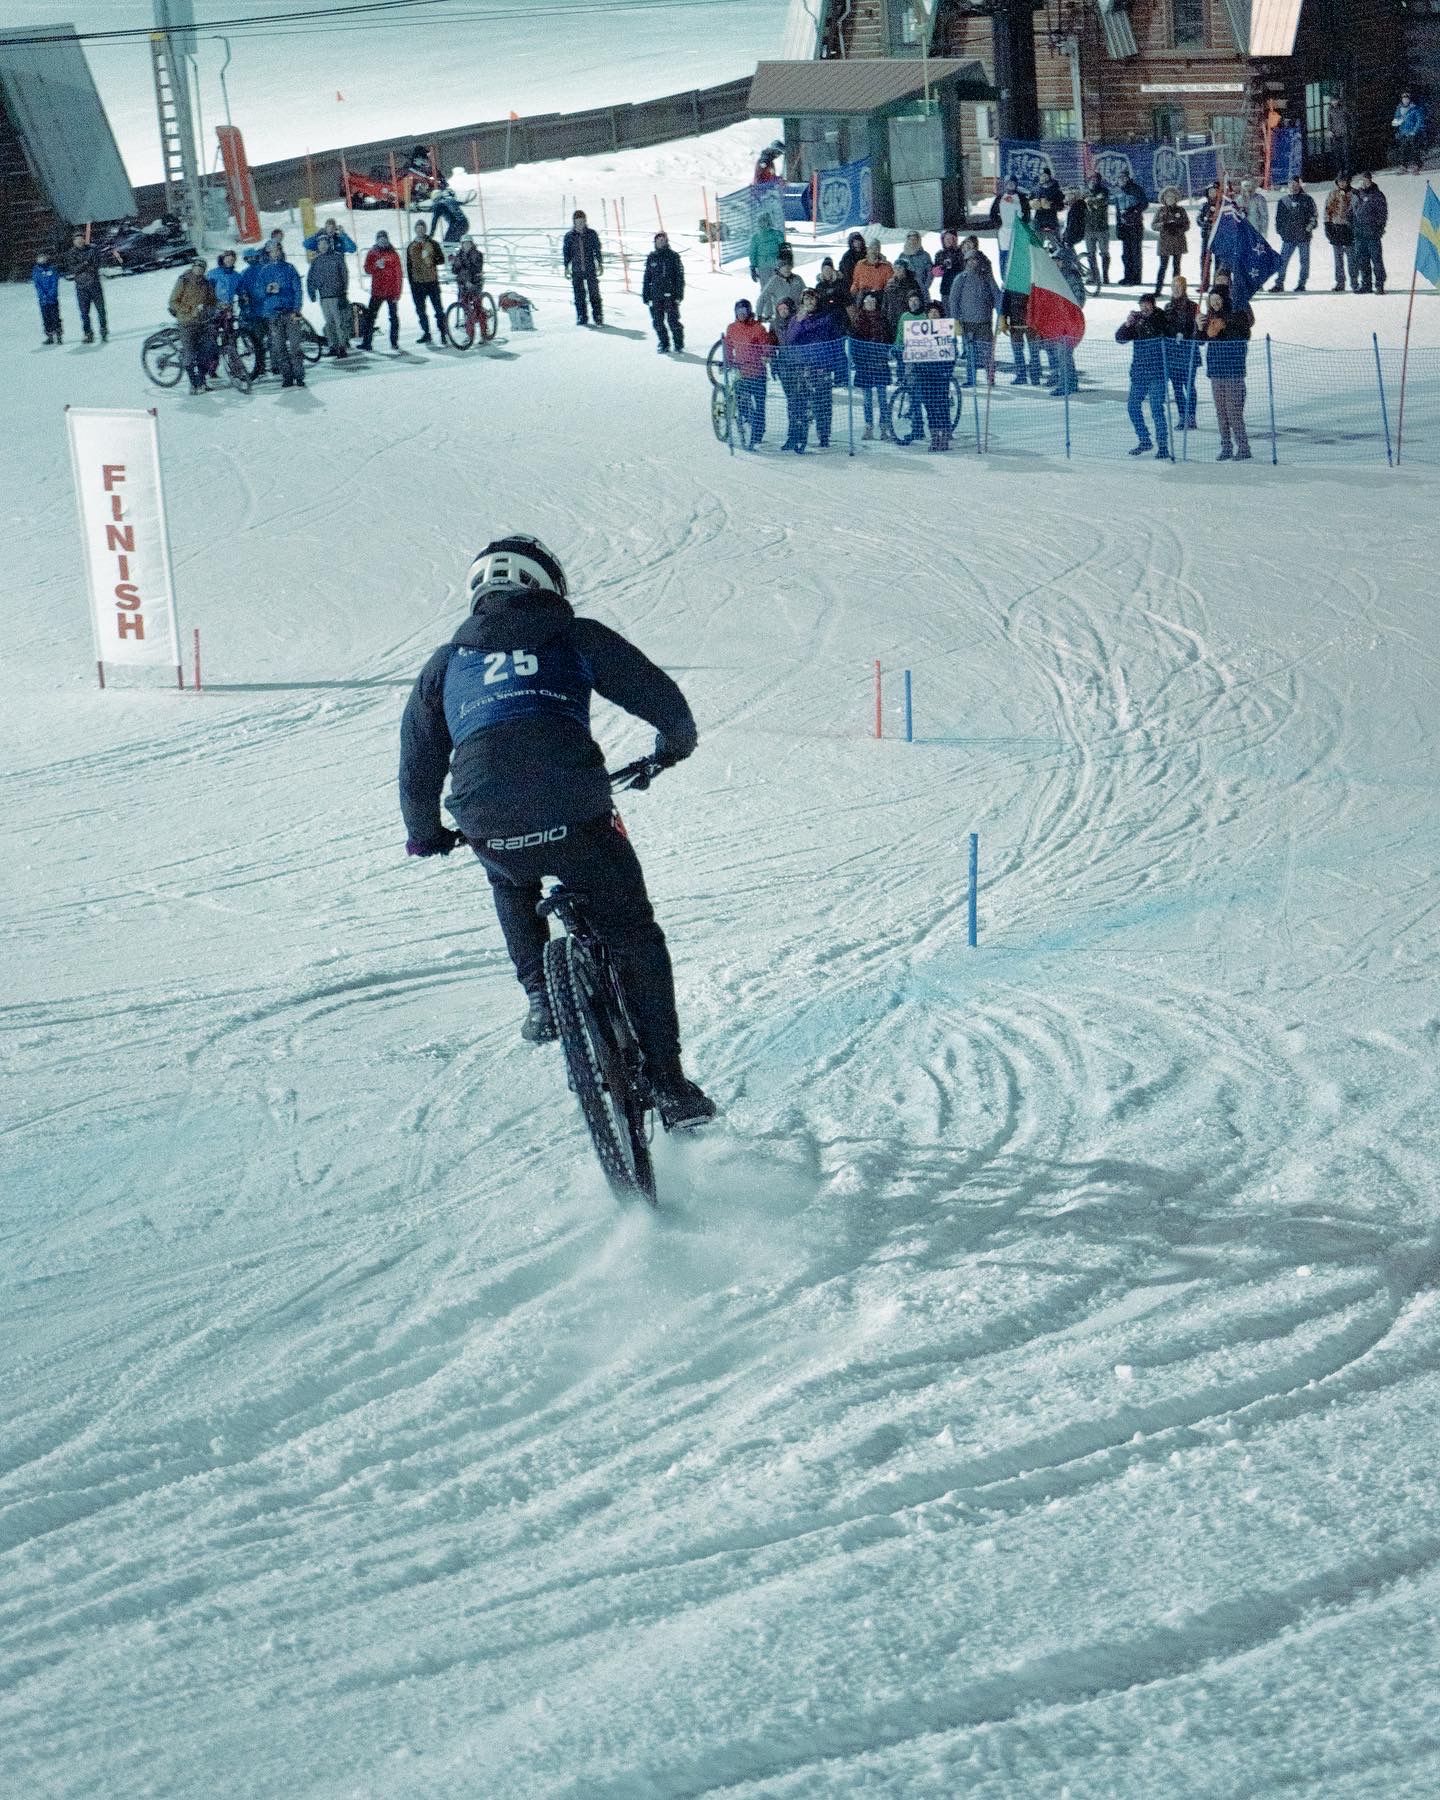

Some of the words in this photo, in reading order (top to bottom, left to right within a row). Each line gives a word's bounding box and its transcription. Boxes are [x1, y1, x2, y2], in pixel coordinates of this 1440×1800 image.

[934, 335, 952, 346] THE
[102, 465, 144, 640] FINISH
[484, 649, 538, 685] 25
[487, 826, 567, 850] RADIO
